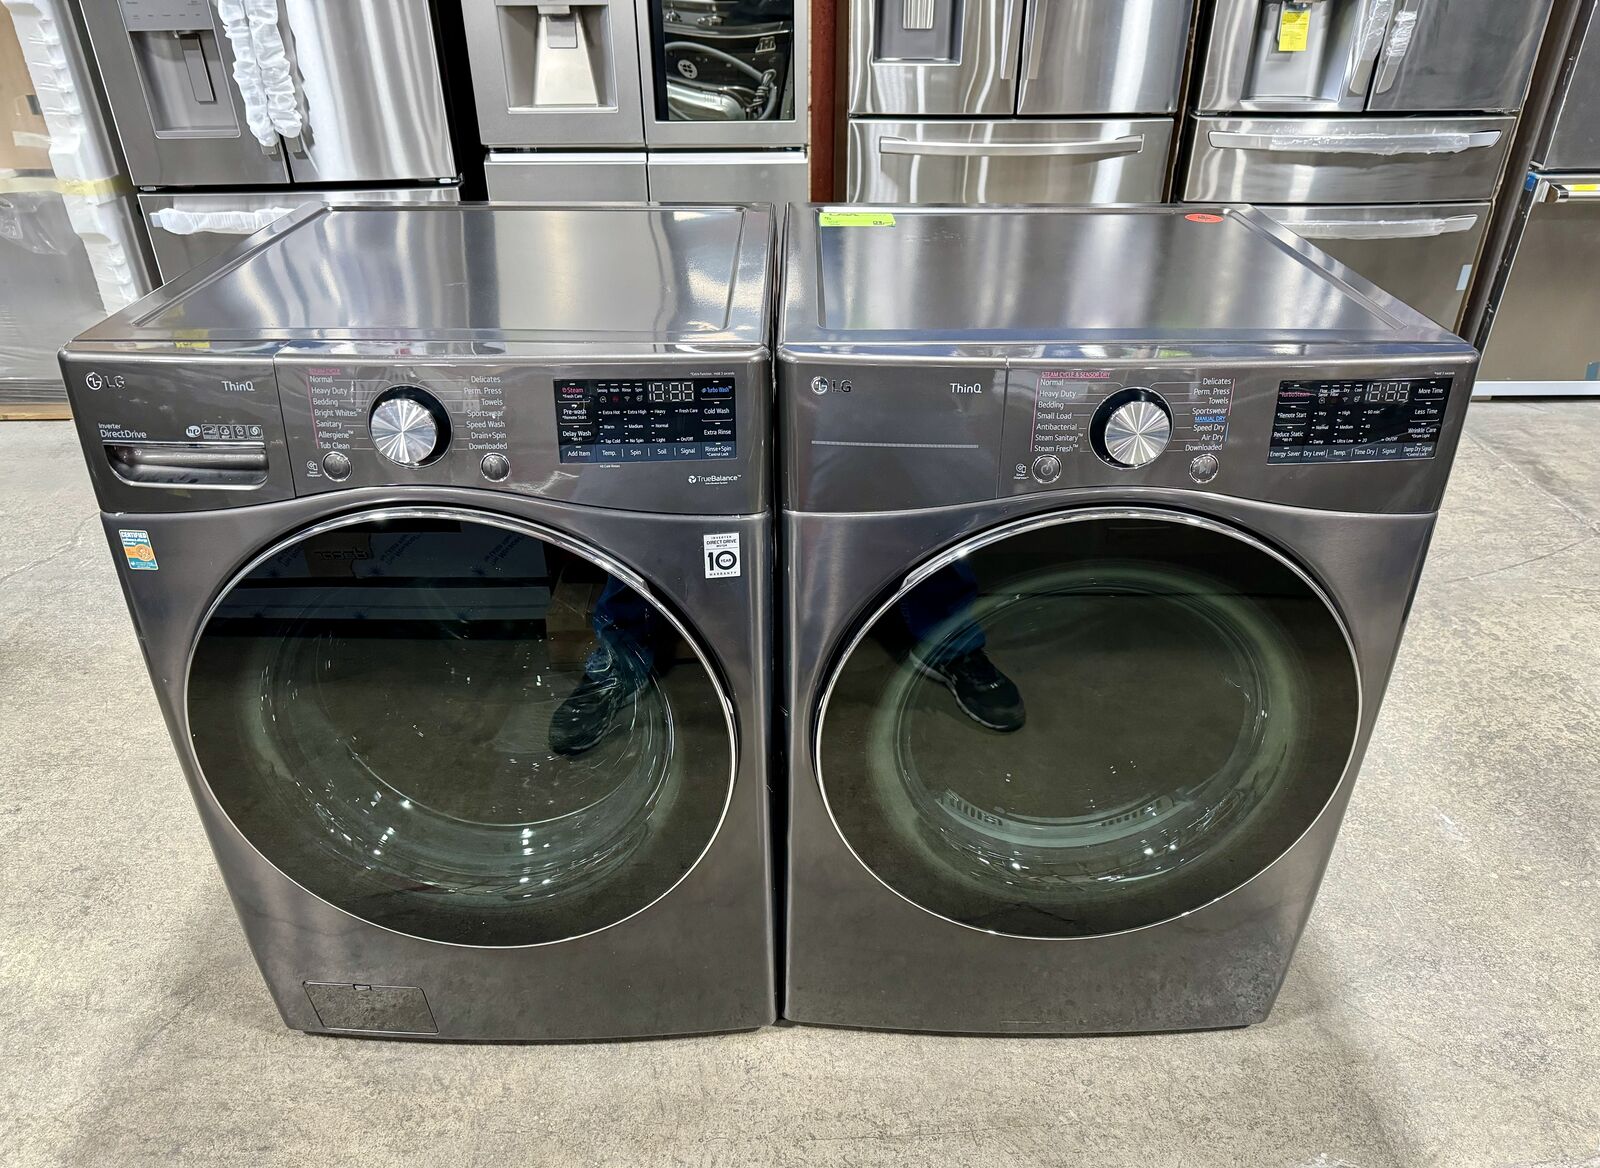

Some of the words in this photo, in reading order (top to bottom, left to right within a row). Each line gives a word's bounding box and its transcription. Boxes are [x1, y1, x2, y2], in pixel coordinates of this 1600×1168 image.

[222, 381, 255, 392] ThinQ
[312, 387, 330, 396] Heavy
[332, 386, 348, 396] Duty
[464, 387, 482, 395] Perm.
[484, 386, 502, 394] Press
[950, 383, 982, 394] ThinQ
[1061, 390, 1076, 398] Duty
[312, 398, 338, 407] Bedding
[1038, 401, 1064, 410] Bedding
[314, 409, 334, 418] Bright
[467, 410, 504, 418] Sportswear
[1192, 408, 1227, 416] Sportswear
[316, 420, 342, 430] Sanitary
[466, 420, 486, 430] Speed
[1193, 424, 1212, 432] Speed
[1214, 424, 1225, 432] Dry
[471, 431, 506, 440] Drain+Spin
[1212, 434, 1224, 442] Dry
[708, 551, 737, 571] 10
